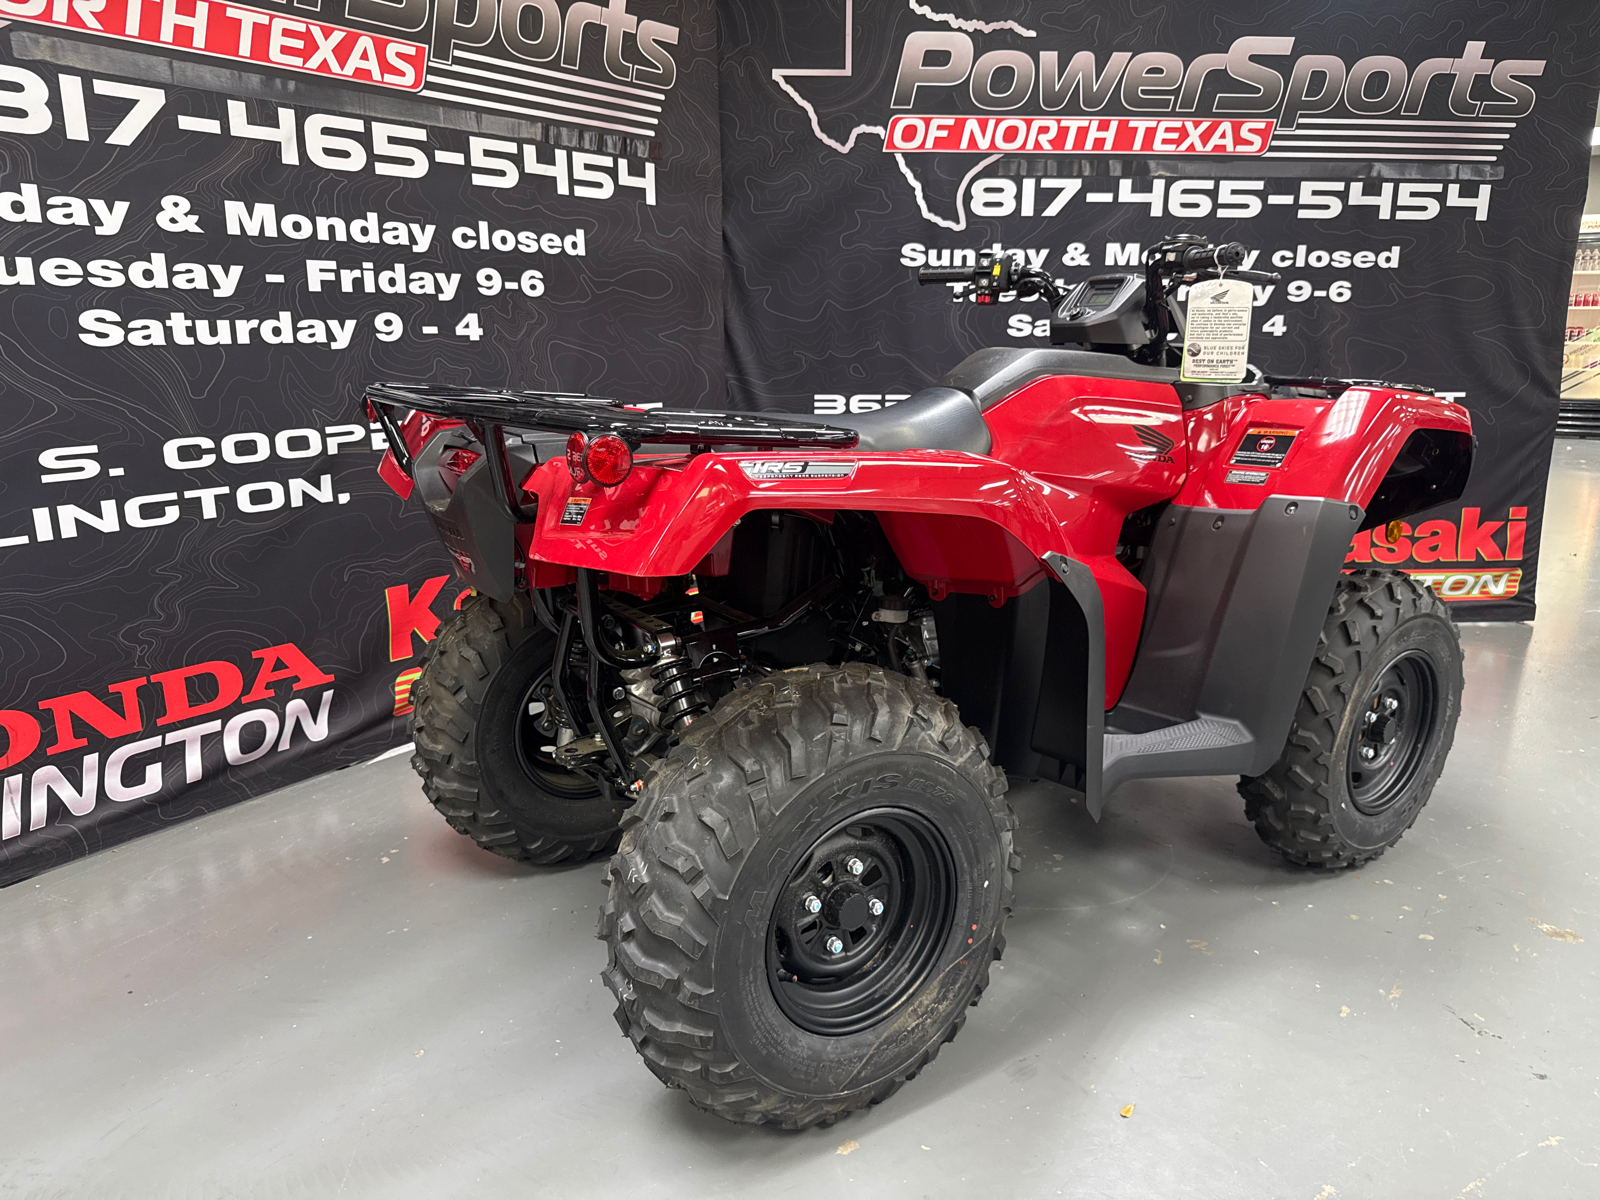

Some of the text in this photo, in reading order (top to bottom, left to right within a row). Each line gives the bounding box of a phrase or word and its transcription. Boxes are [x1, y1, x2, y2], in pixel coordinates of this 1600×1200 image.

[226, 6, 417, 87] TEXAS
[892, 117, 1267, 153] OF NORTH TEXAS
[970, 178, 1492, 221] 817-465-5454
[155, 194, 205, 234] &
[223, 199, 437, 253] Monday
[451, 220, 587, 257] closed
[1061, 242, 1091, 267] &
[1271, 244, 1401, 269] closed
[305, 259, 462, 302] Friday
[475, 267, 546, 298] 9-6
[1286, 280, 1353, 303] 9-6
[78, 308, 358, 350] Saturday
[373, 311, 404, 343] 9
[455, 312, 484, 341] 4
[1261, 314, 1288, 337] 4
[38, 444, 126, 484] S.
